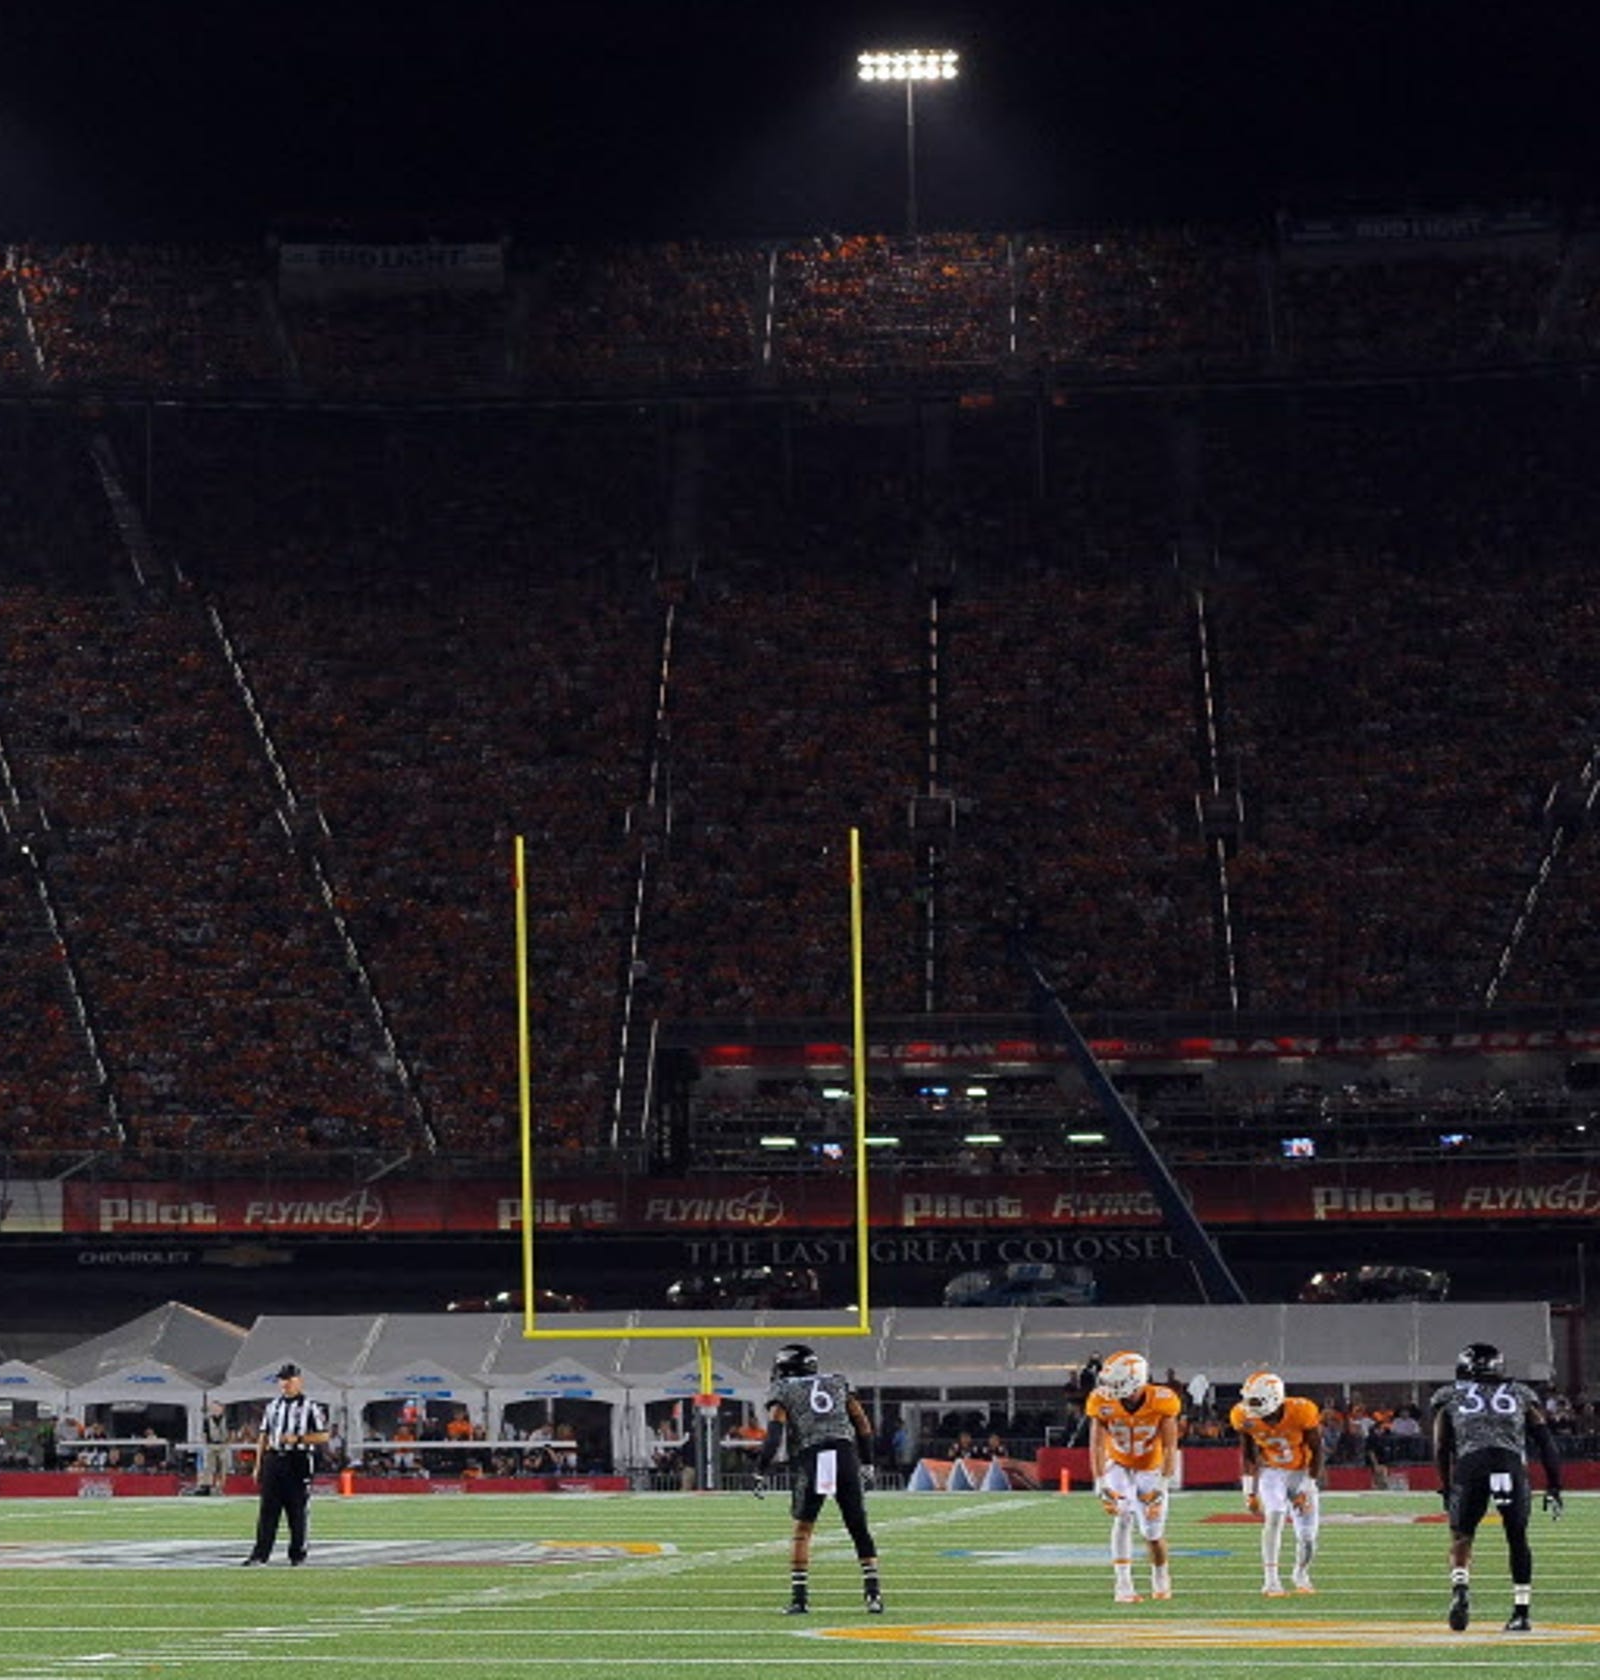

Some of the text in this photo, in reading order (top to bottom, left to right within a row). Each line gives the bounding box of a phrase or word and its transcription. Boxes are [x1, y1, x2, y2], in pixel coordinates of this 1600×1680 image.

[99, 1198, 217, 1232] Pilot
[243, 1201, 346, 1225] FLYING
[645, 1198, 747, 1223] FLYING
[1312, 1187, 1435, 1221] Pilot
[1460, 1185, 1568, 1212] FLYING
[78, 1250, 191, 1265] CHEVROLET
[685, 1240, 755, 1265] THE
[771, 1238, 850, 1265] LAST
[871, 1237, 989, 1264] GREAT
[809, 1379, 834, 1415] 6
[1455, 1381, 1518, 1415] 36
[1265, 1436, 1294, 1464] 3
